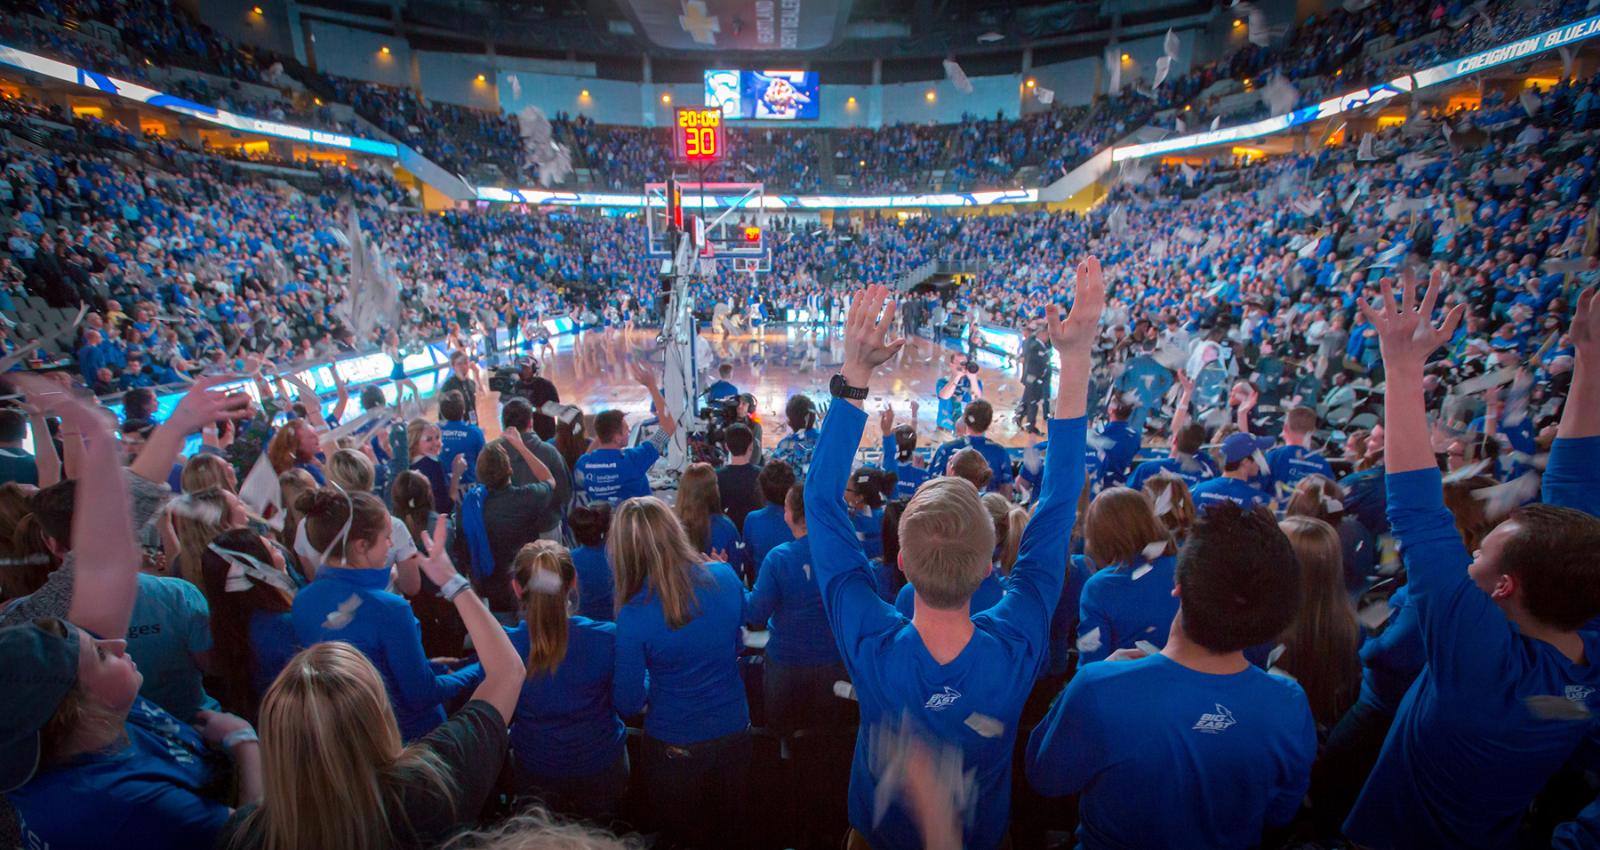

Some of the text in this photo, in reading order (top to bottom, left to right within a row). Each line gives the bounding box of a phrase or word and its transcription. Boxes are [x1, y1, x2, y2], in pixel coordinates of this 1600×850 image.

[1456, 37, 1540, 74] CREIGHTON
[686, 128, 714, 155] 30
[1195, 720, 1231, 729] EAST
[1200, 713, 1226, 721] BIG
